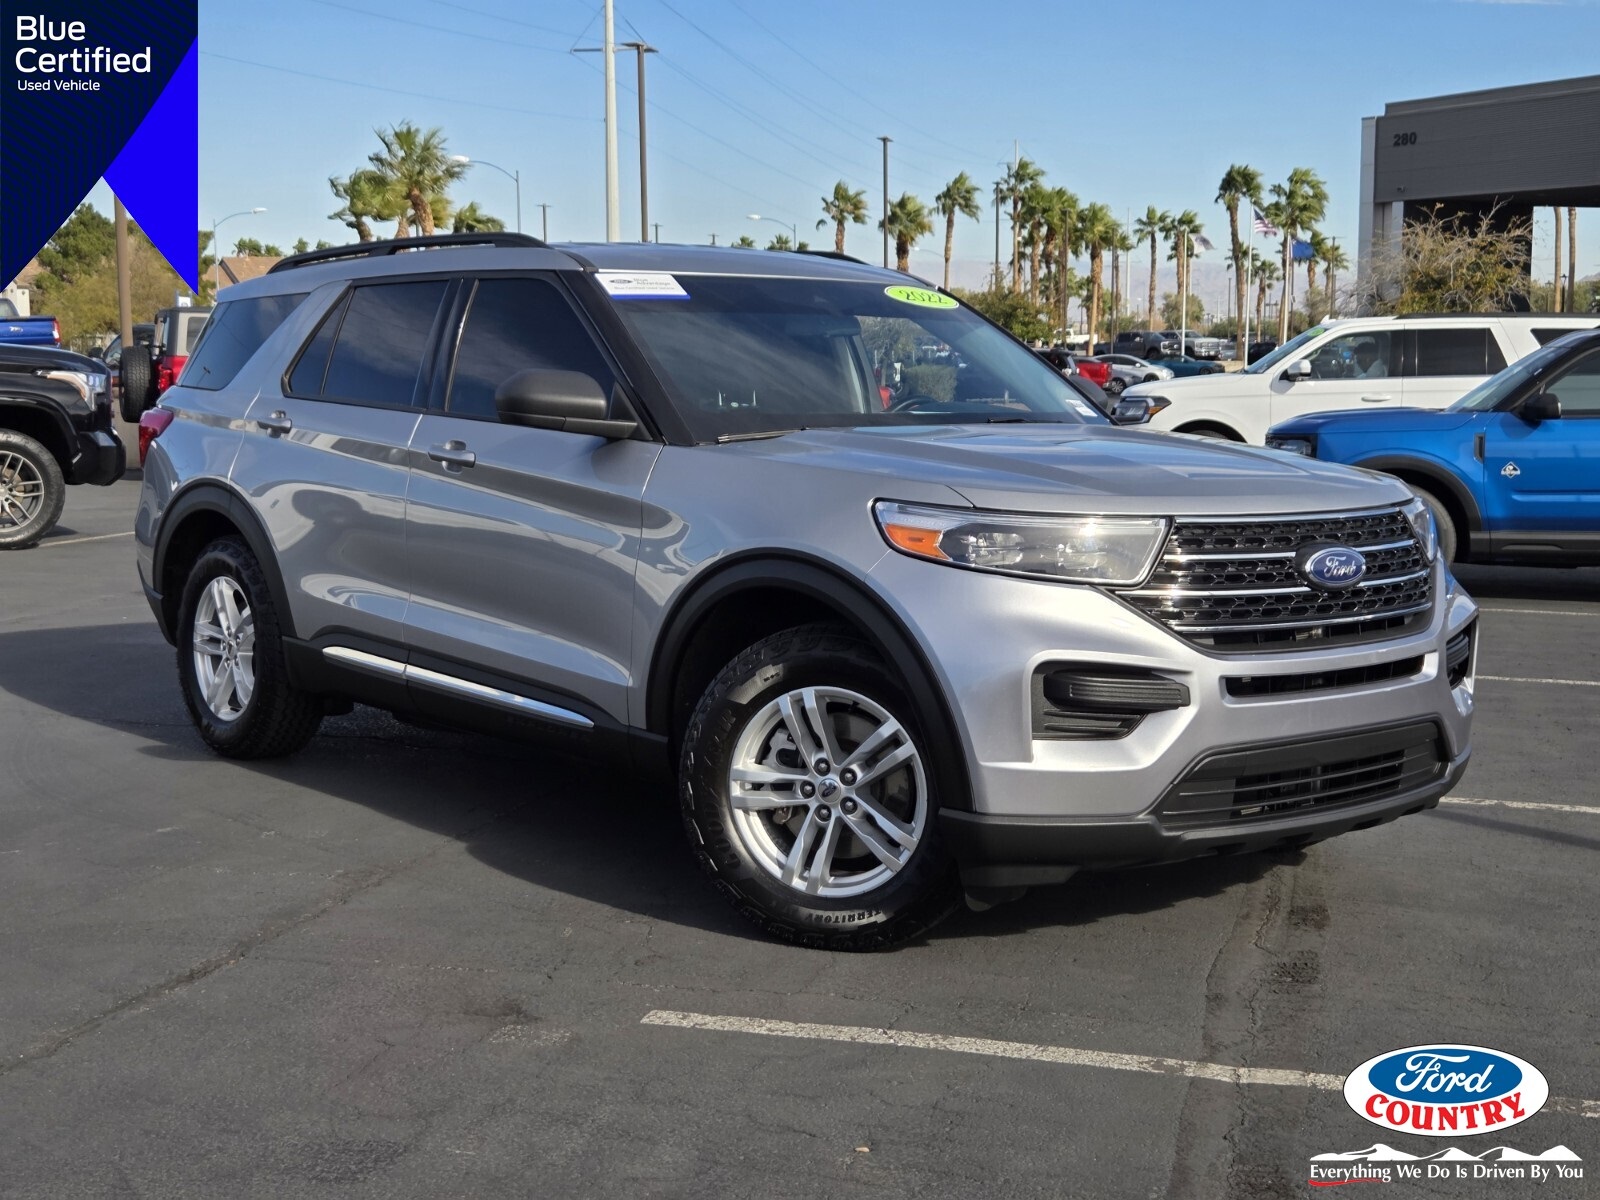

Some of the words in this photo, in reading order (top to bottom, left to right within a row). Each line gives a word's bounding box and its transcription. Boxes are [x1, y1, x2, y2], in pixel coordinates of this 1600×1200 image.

[1393, 132, 1417, 147] 280
[898, 289, 948, 304] 2022
[1323, 555, 1357, 578] Ford
[803, 907, 882, 924] TERRITORY
